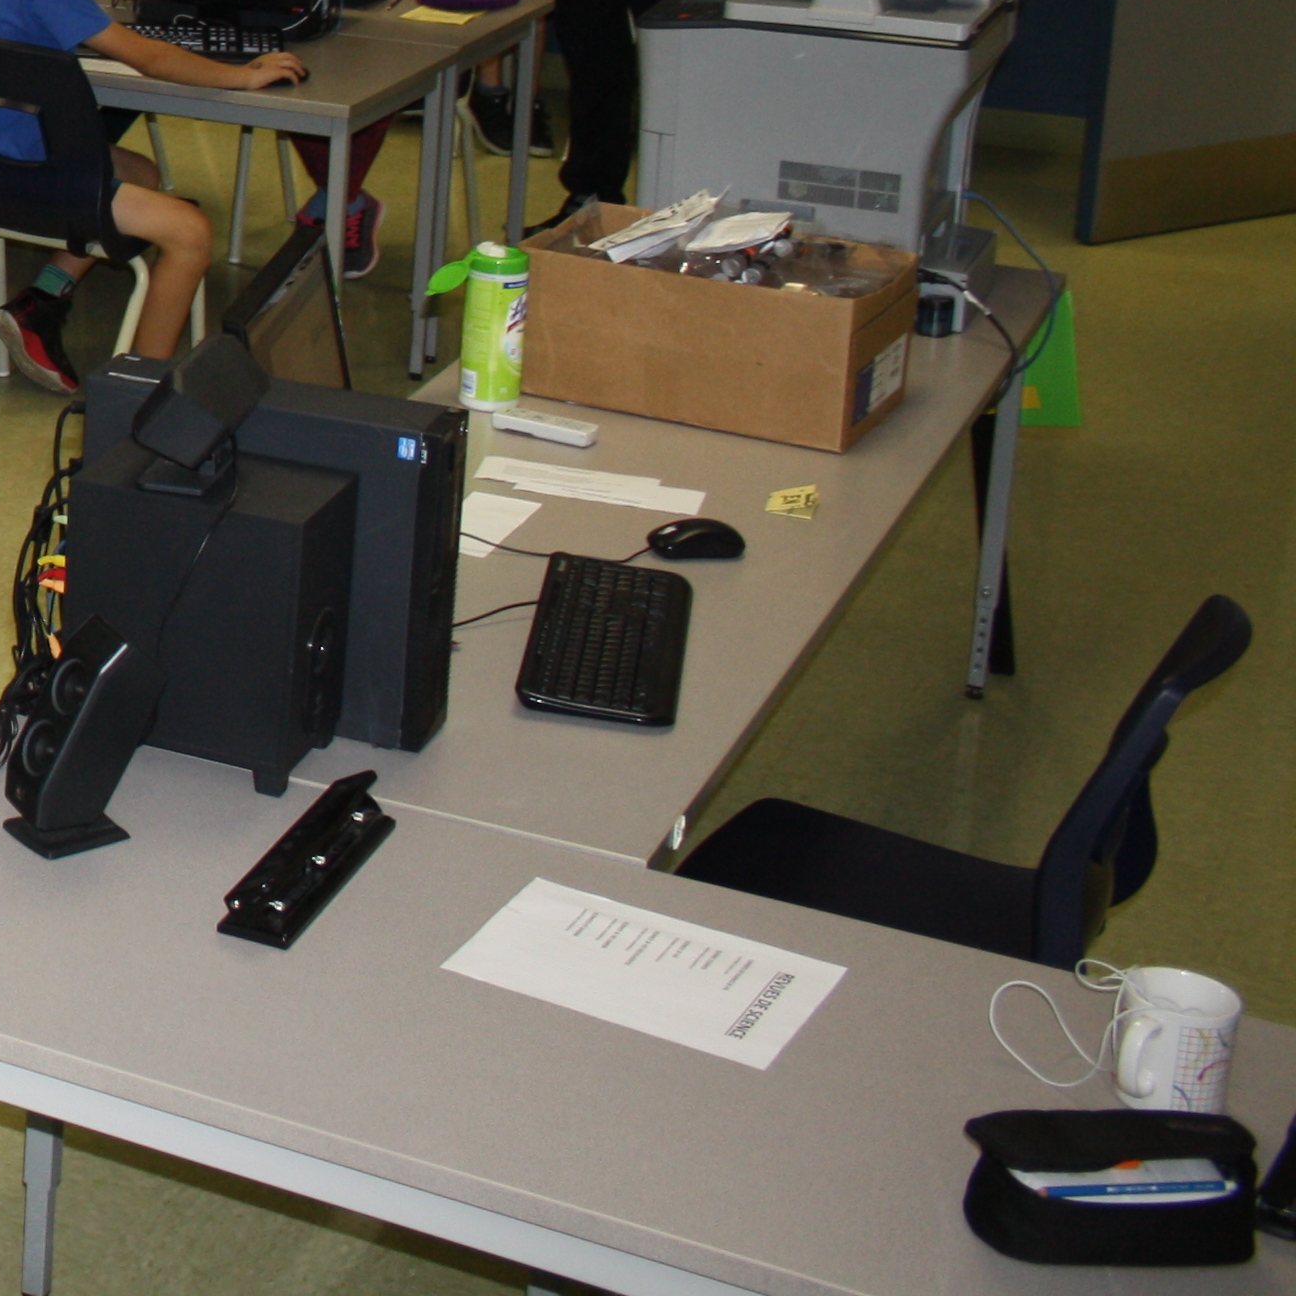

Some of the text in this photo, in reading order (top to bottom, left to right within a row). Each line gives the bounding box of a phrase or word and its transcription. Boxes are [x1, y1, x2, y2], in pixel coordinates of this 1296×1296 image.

[762, 972, 795, 1000] REVUES
[754, 998, 773, 1011] DE
[728, 1009, 764, 1040] SCIENCE
